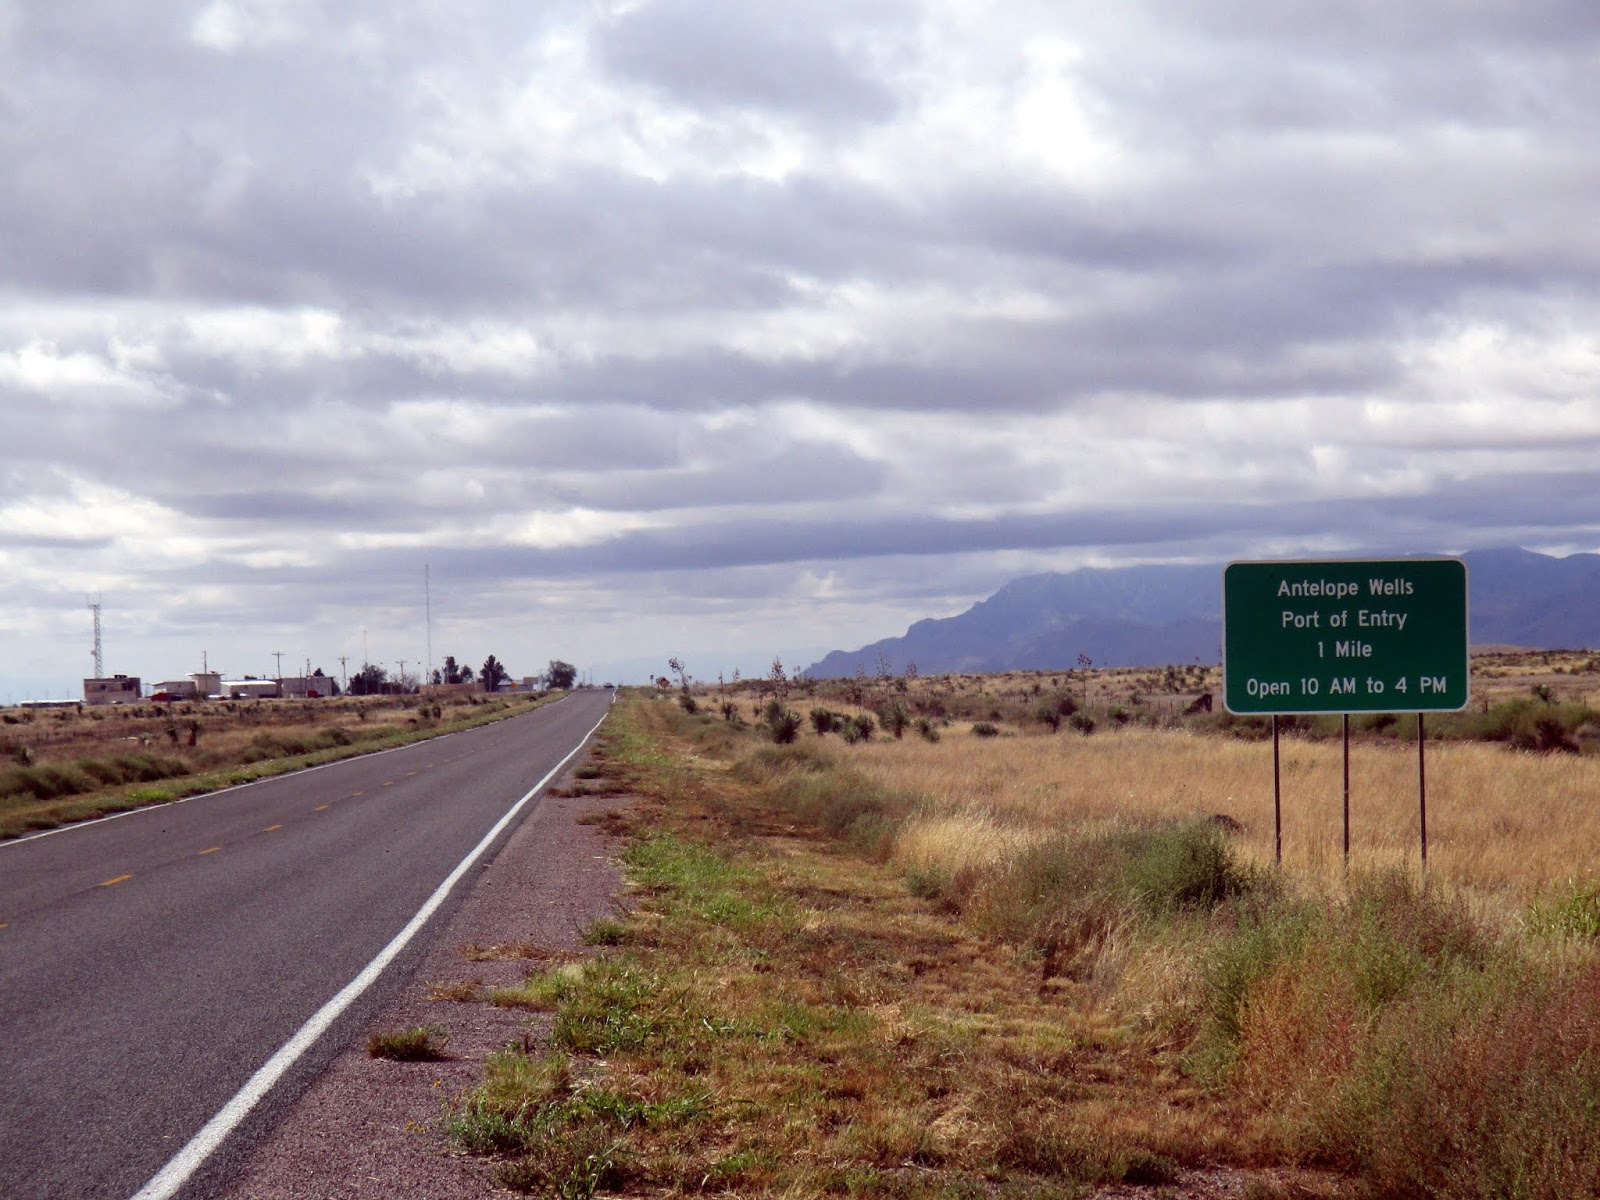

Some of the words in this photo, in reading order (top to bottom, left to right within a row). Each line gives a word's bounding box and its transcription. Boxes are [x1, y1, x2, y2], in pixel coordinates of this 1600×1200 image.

[1278, 579, 1359, 599] Antelope
[1370, 578, 1414, 595] Wells
[1282, 611, 1319, 628] Port
[1330, 611, 1347, 628] of
[1359, 610, 1407, 629] Entry
[1318, 641, 1323, 658] 1
[1336, 641, 1372, 658] Mile
[1247, 679, 1289, 698] Open
[1301, 678, 1319, 695] 10
[1330, 678, 1355, 694] AM
[1367, 676, 1384, 694] to
[1395, 677, 1407, 694] 4
[1420, 676, 1447, 694] PM
